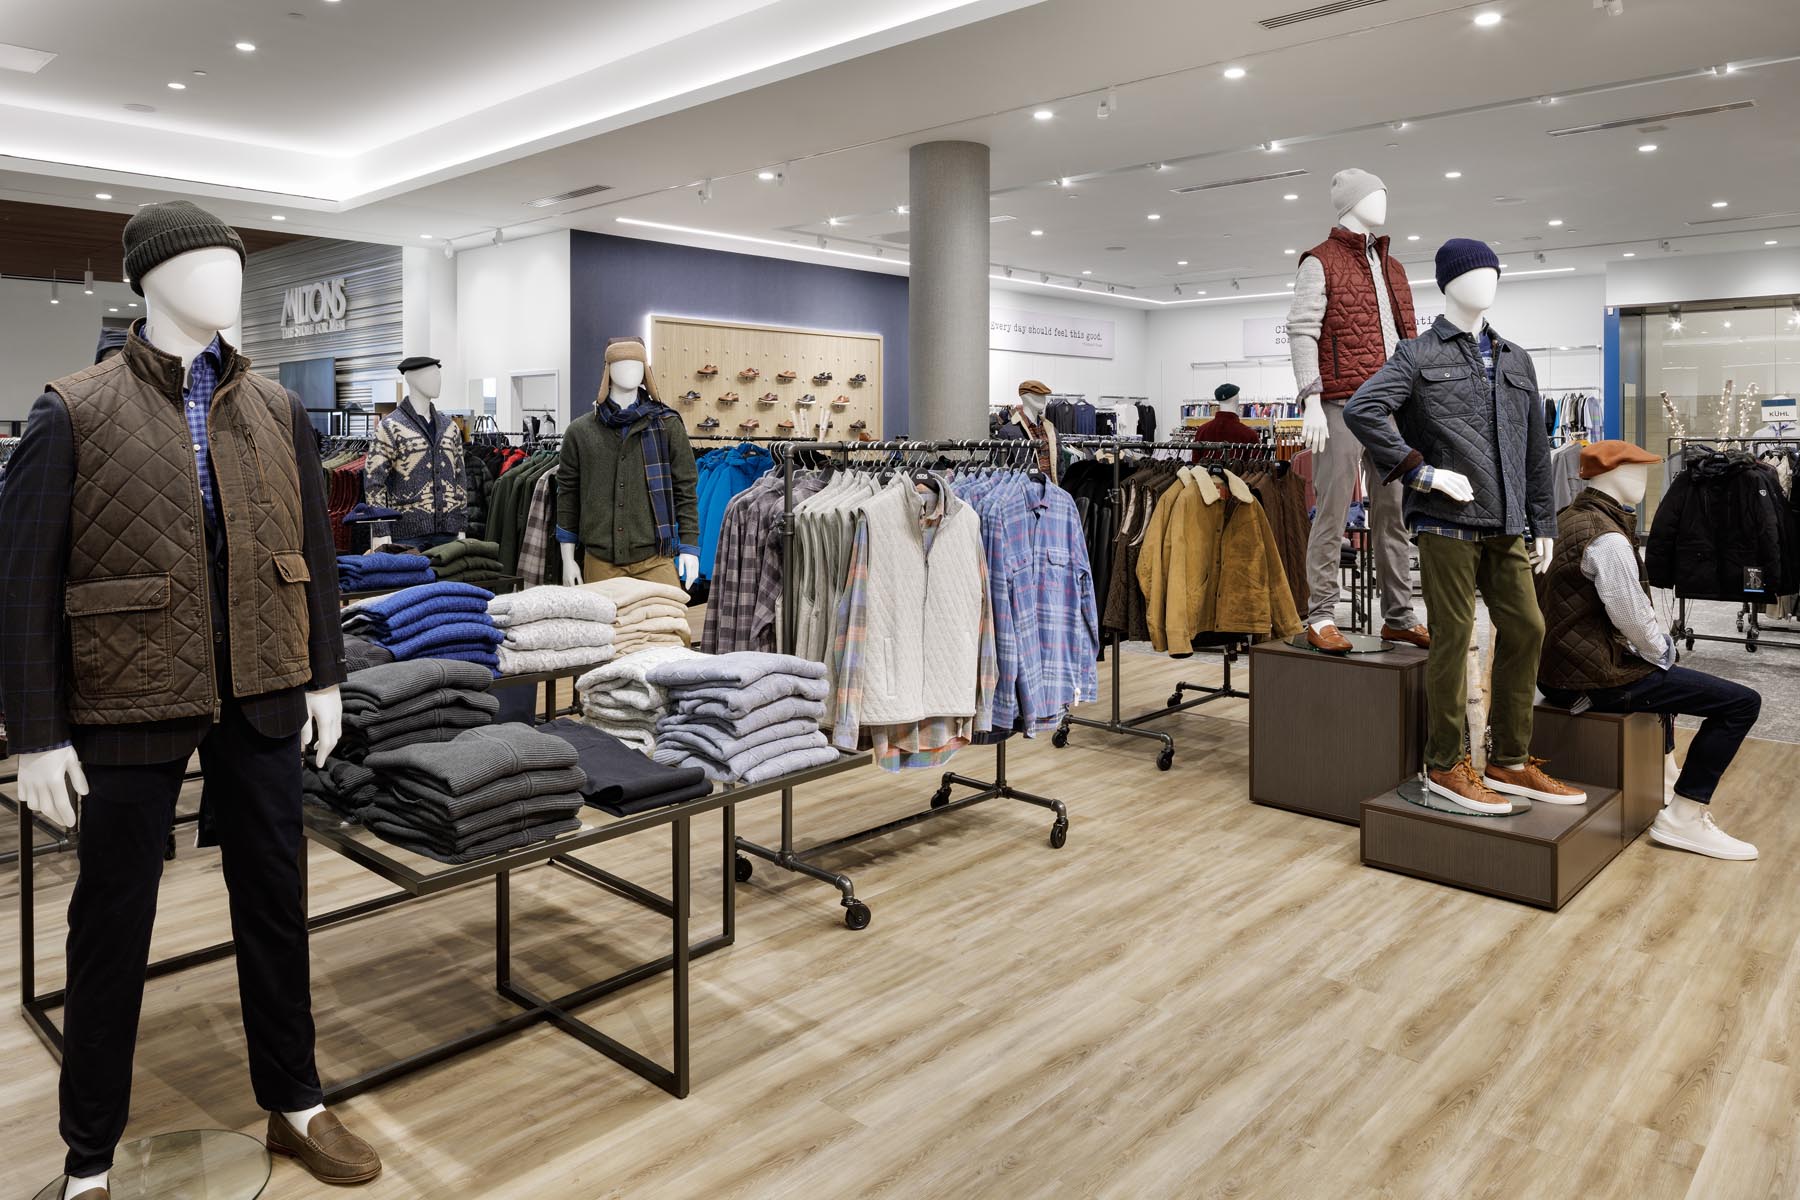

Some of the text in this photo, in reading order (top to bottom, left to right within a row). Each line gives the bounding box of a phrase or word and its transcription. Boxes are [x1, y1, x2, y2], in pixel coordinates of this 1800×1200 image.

[281, 278, 346, 326] MILTONS
[990, 321, 1011, 333] Every
[1014, 323, 1026, 334] day
[1028, 324, 1052, 336] should
[1054, 328, 1068, 337] feel
[1070, 330, 1084, 339] this
